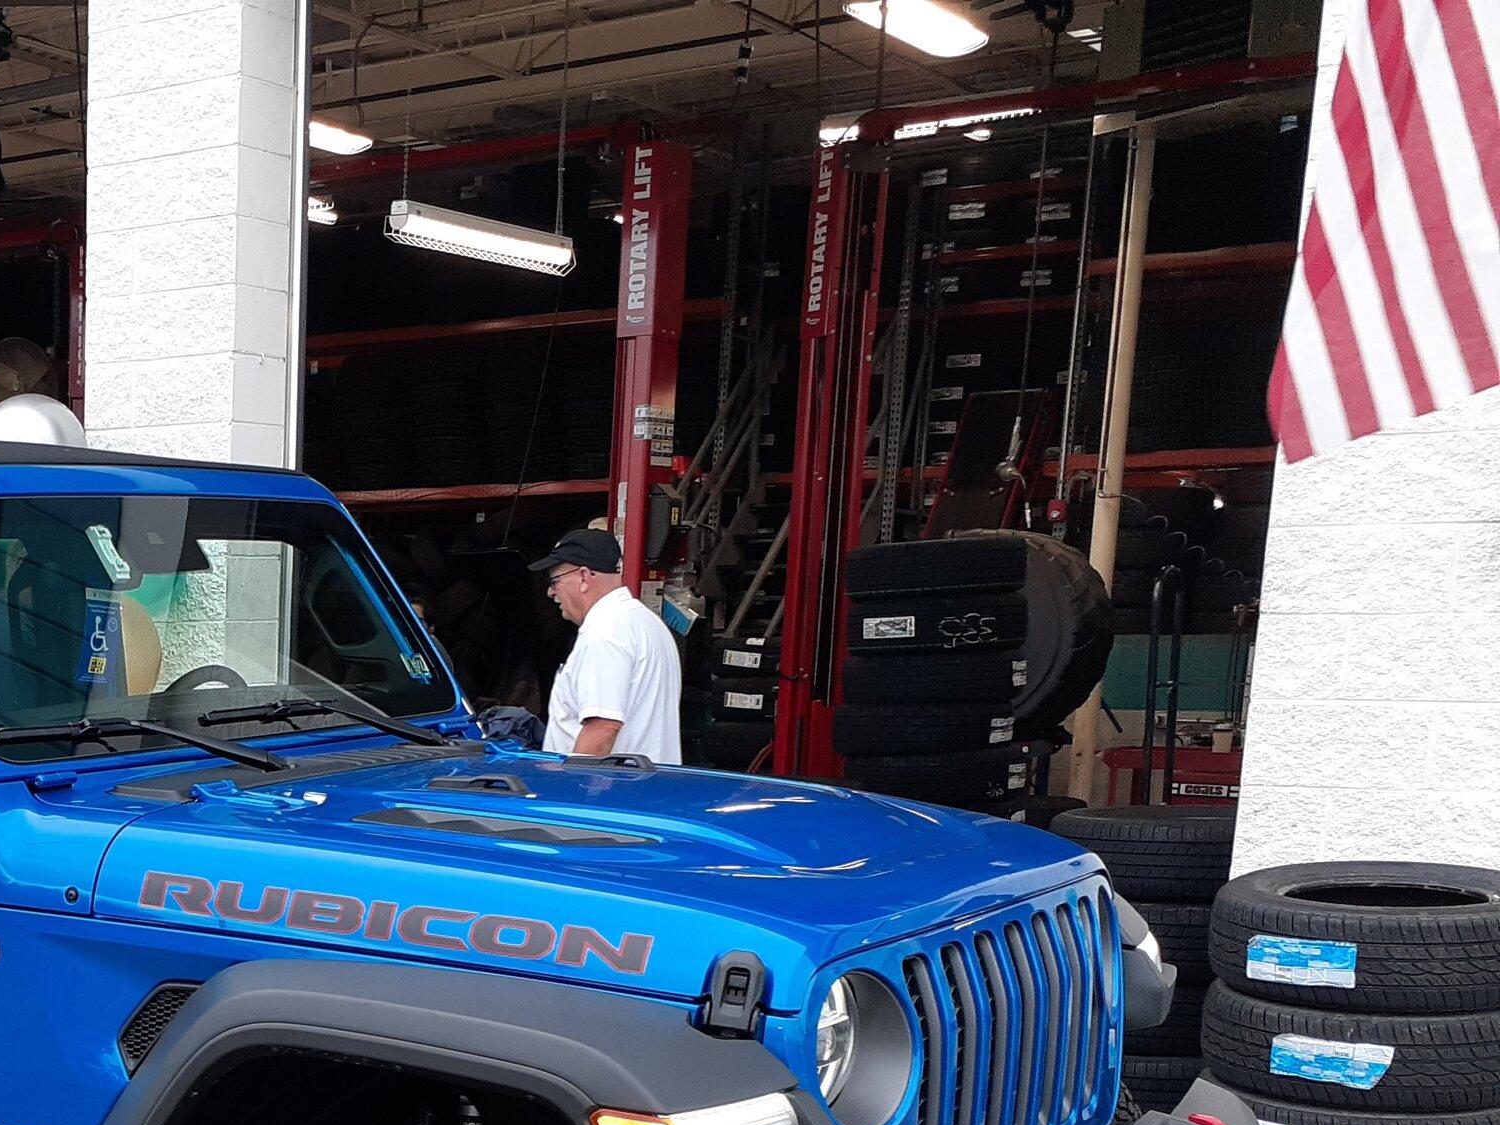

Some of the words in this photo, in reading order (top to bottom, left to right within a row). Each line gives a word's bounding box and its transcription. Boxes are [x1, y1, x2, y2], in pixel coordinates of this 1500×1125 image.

[633, 146, 653, 200] LIFT
[817, 150, 834, 203] LIFT
[627, 209, 649, 310] ROTARY
[807, 212, 828, 312] ROTARY
[139, 870, 654, 975] RUBICON
